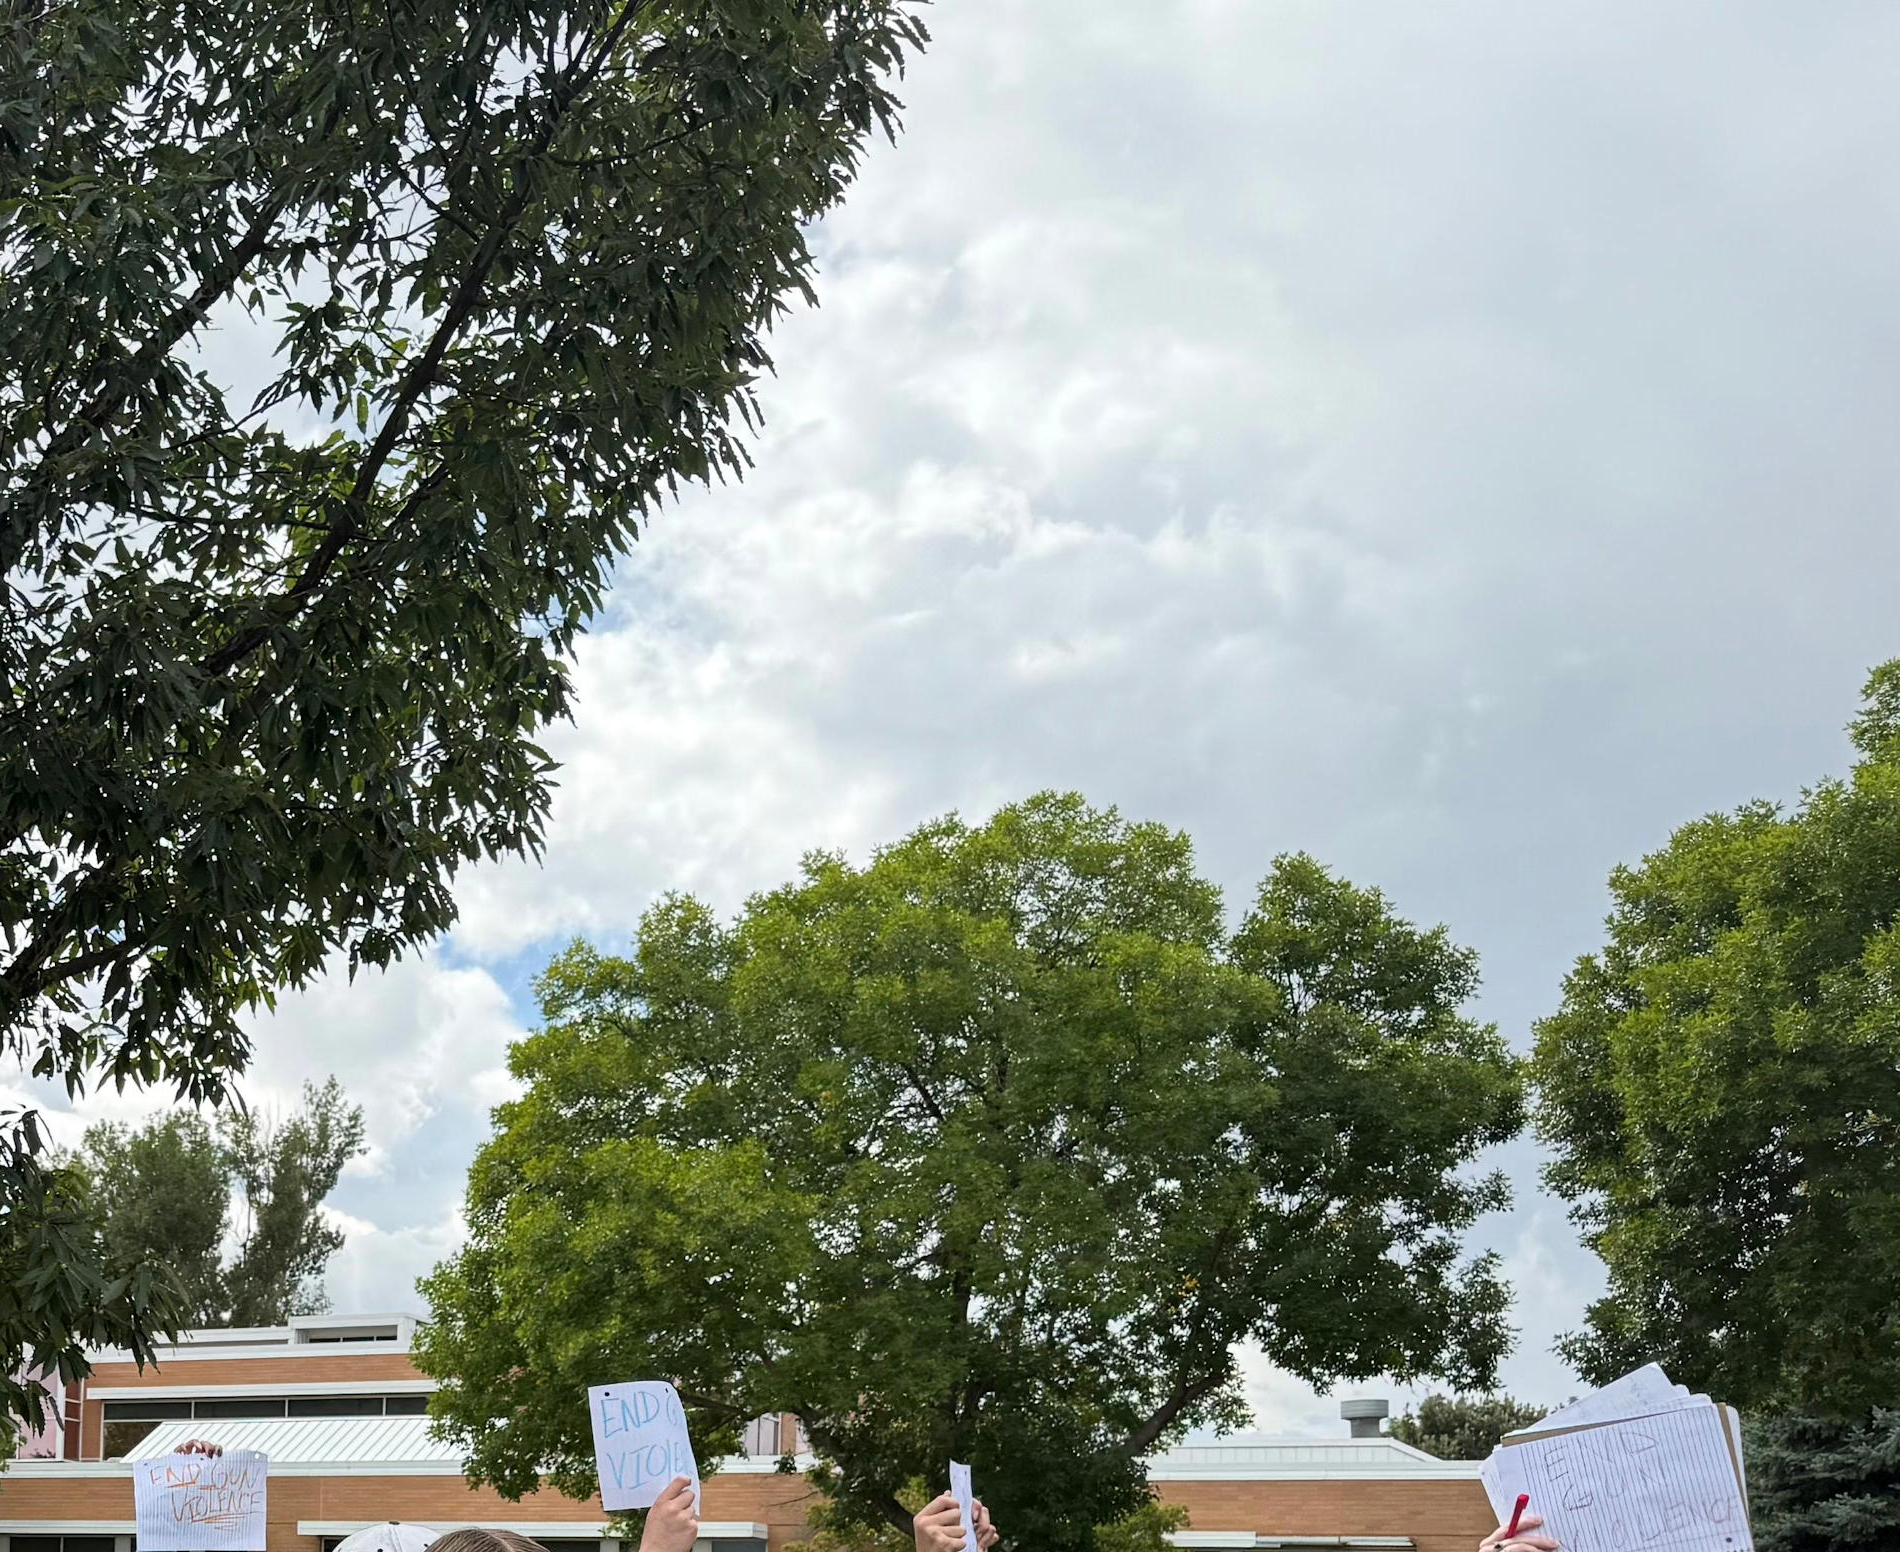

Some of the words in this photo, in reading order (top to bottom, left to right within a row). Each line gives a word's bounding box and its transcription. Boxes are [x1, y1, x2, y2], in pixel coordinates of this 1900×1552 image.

[601, 1391, 659, 1438] END
[150, 1463, 202, 1484] END
[1544, 1431, 1660, 1482] END
[1562, 1456, 1671, 1511] GUN
